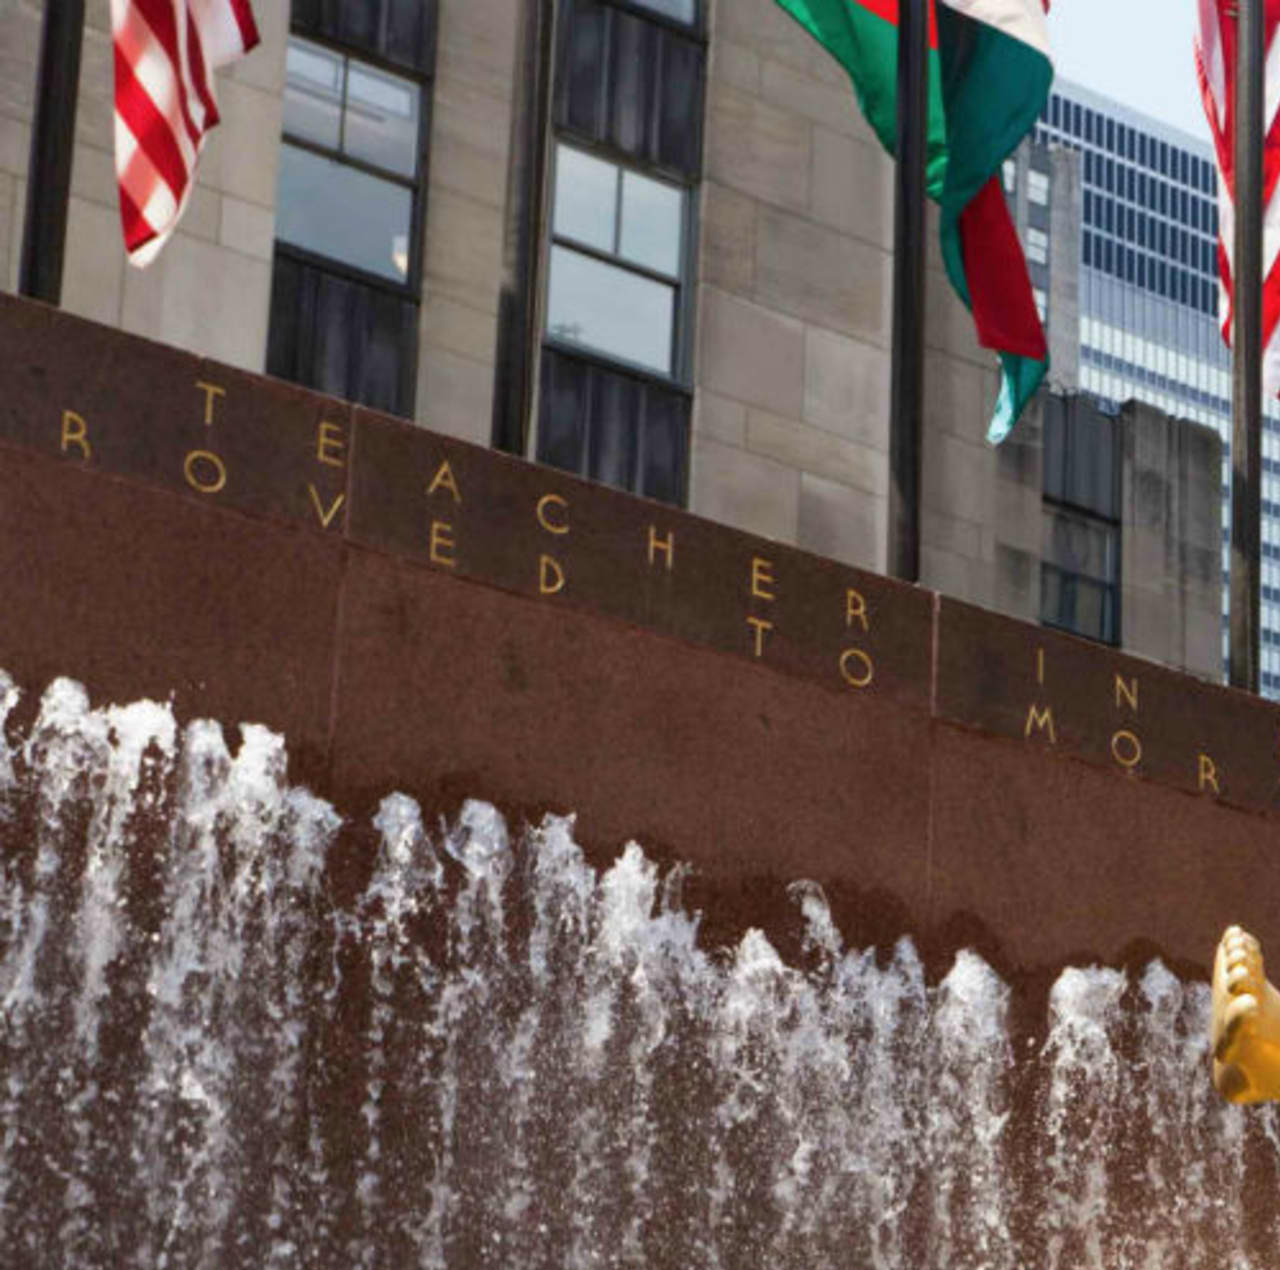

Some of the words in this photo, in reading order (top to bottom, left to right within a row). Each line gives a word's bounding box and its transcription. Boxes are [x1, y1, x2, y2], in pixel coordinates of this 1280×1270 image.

[60, 410, 566, 595] ROVED
[745, 615, 874, 688] TO
[195, 381, 869, 632] TEACHER
[1035, 647, 1139, 711] IN
